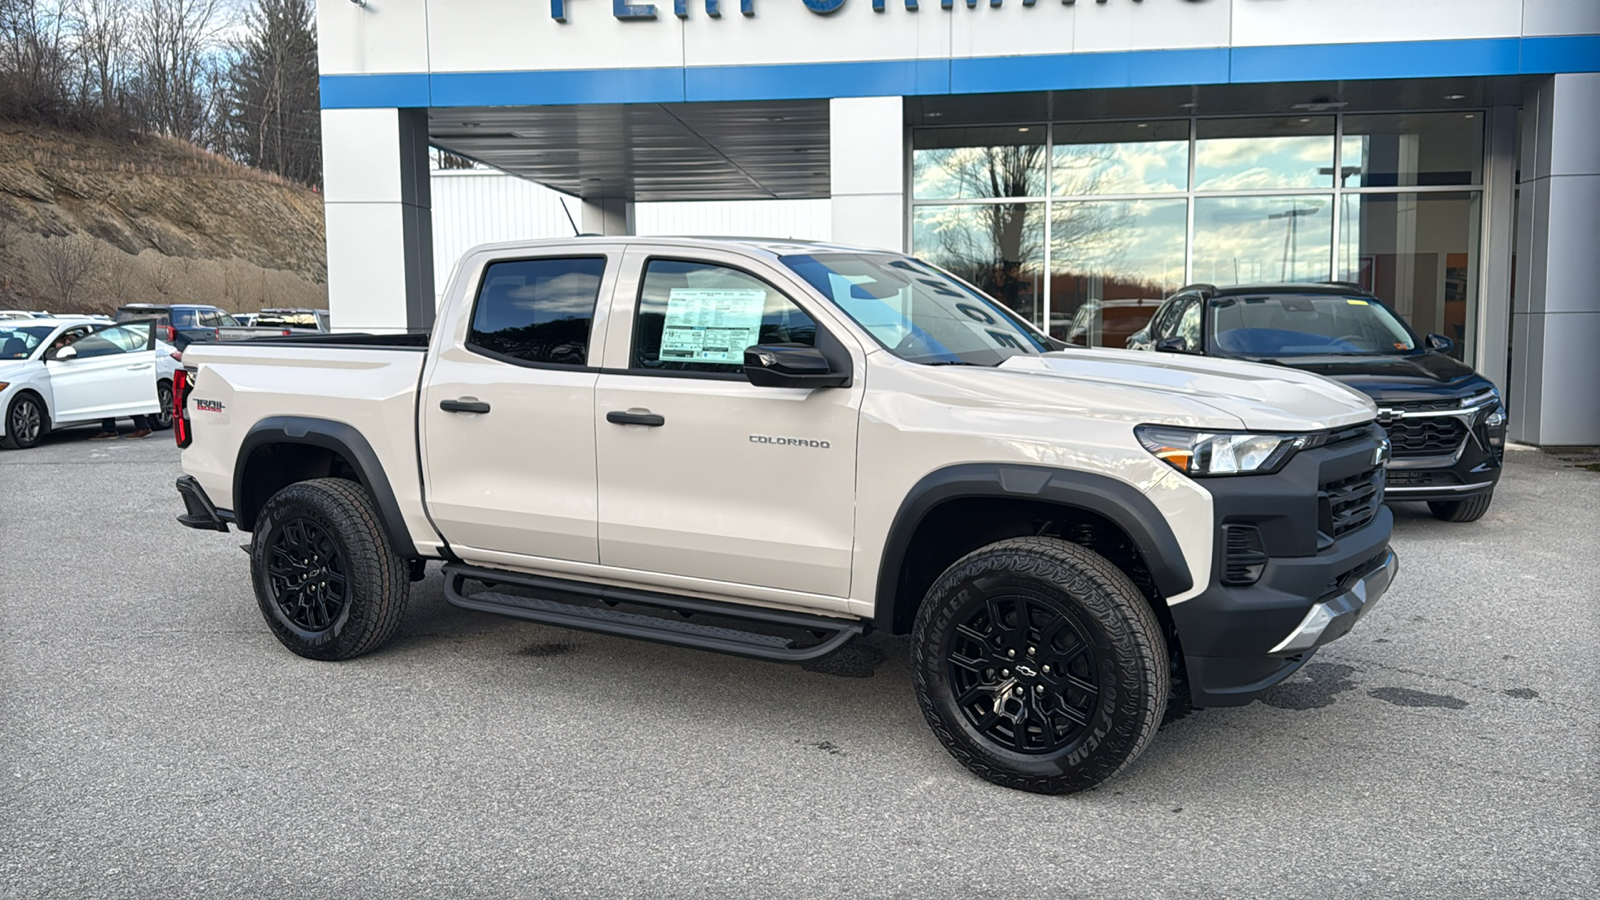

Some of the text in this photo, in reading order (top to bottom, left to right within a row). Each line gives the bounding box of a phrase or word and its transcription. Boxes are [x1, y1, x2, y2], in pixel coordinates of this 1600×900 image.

[192, 398, 226, 409] TRAIL
[196, 405, 222, 413] BOSS
[749, 435, 830, 449] COLORADO
[1066, 658, 1118, 767] GOODYEAR
